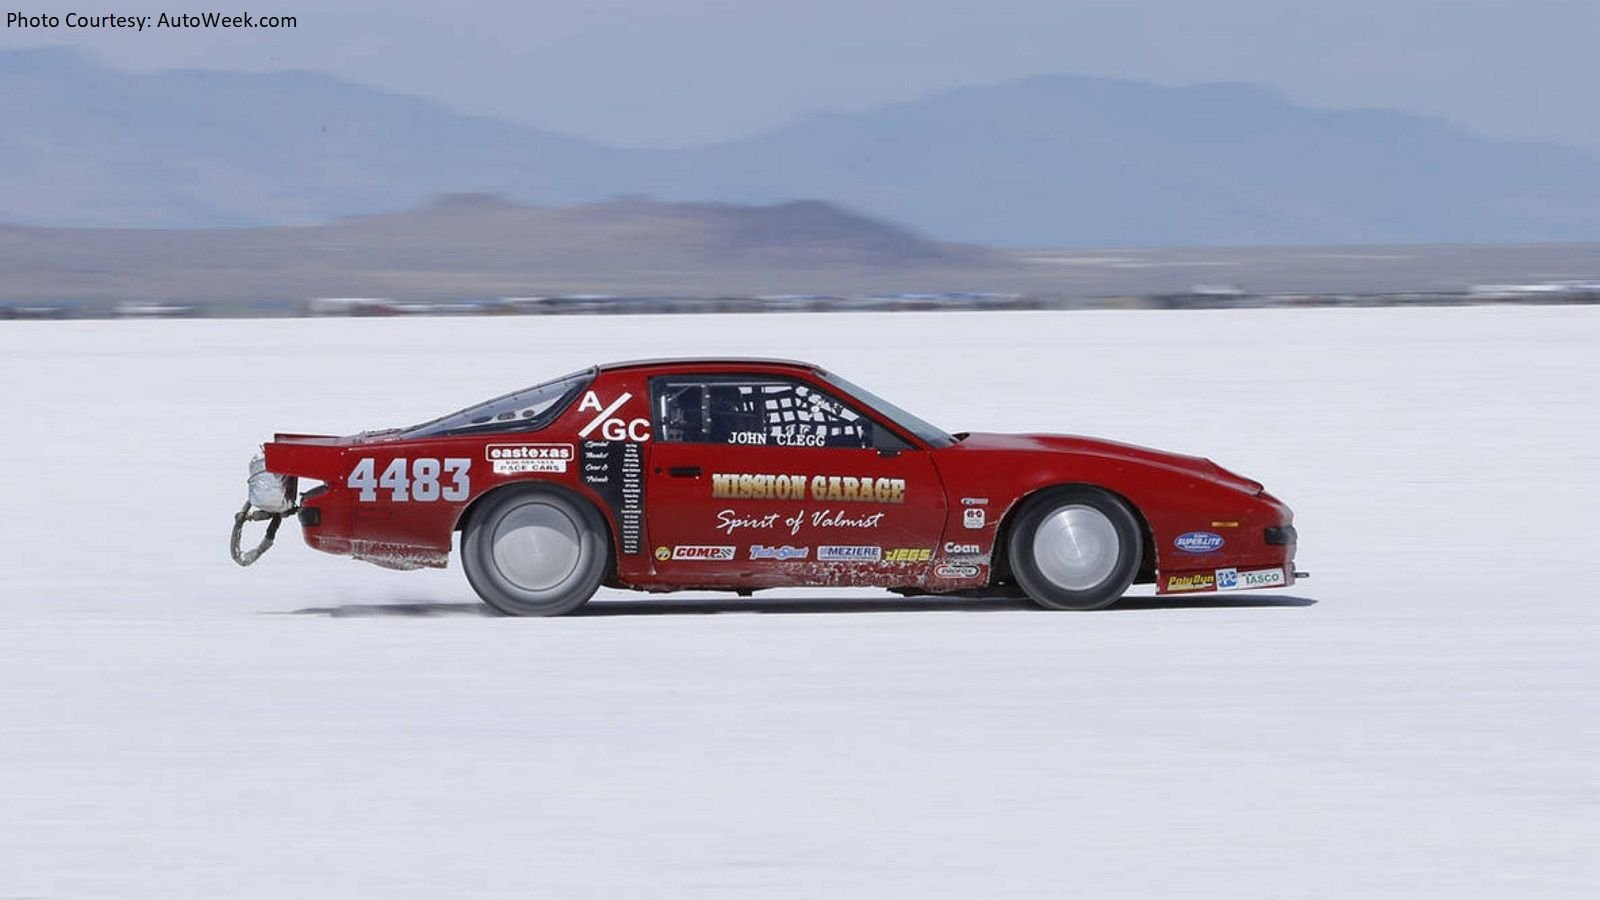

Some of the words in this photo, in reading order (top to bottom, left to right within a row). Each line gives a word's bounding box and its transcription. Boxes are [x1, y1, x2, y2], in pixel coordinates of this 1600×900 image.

[728, 432, 767, 445] JOHN
[776, 434, 826, 447] CLEGG
[491, 446, 569, 459] eastexas
[348, 457, 471, 502] 4483
[712, 473, 807, 499] MISSION
[811, 475, 905, 503] GARAGE
[716, 509, 779, 534] Spirit
[785, 510, 804, 535] of
[811, 510, 884, 528] Valmist
[676, 547, 721, 557] COMP
[828, 547, 879, 556] MEZIERE
[944, 542, 979, 553] Coan
[885, 548, 931, 561] JEGS
[1243, 573, 1280, 585] TASCO
